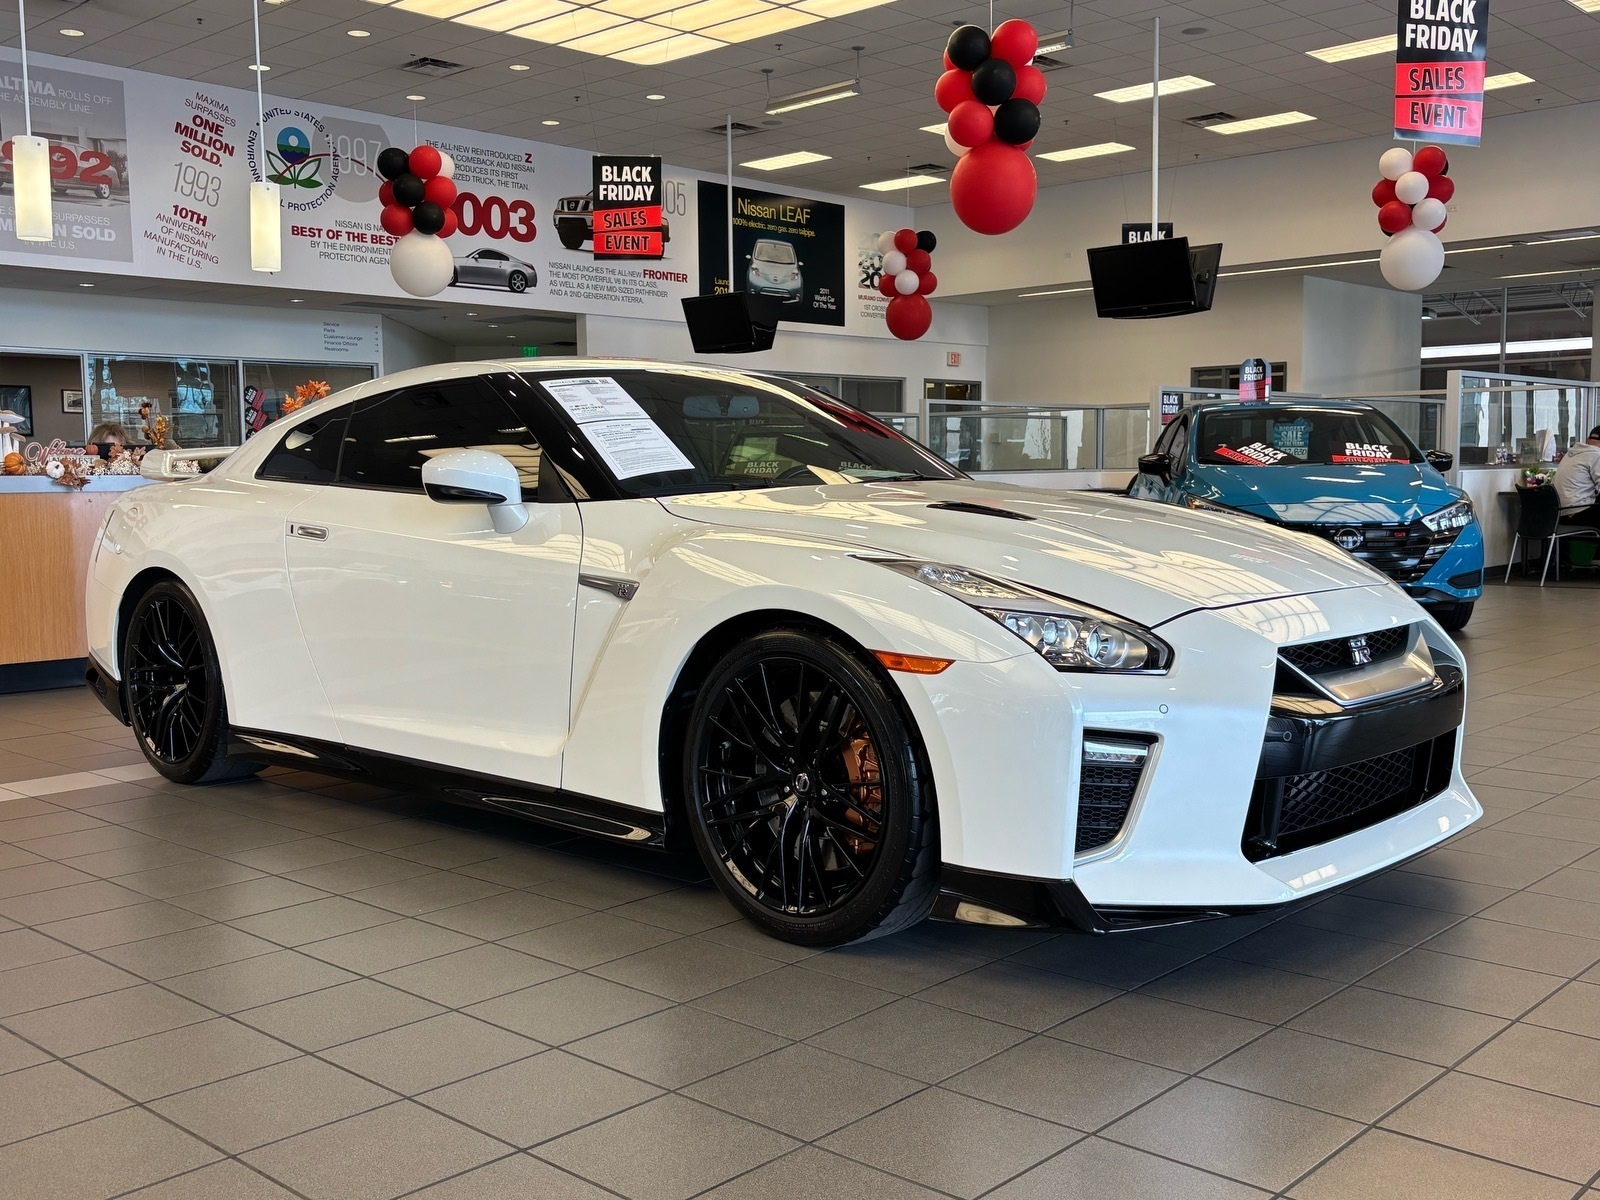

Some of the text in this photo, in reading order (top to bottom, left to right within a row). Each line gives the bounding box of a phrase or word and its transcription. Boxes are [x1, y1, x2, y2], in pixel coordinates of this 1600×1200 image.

[1410, 0, 1475, 24] BLACK
[1406, 23, 1478, 53] FRIDAY
[1410, 67, 1464, 91] SALES
[59, 89, 90, 102] ROLLS
[93, 95, 112, 104] OFF
[196, 92, 229, 113] MAXIMA
[185, 99, 236, 127] SURPASSES
[1410, 102, 1467, 128] EVENT
[192, 114, 224, 137] ONE
[175, 122, 234, 156] MILLION
[181, 140, 222, 167] SOLD.
[324, 134, 381, 178] 1997
[426, 140, 532, 163] THE ALL-NEW REINTRODUCED Z
[455, 164, 488, 175] RODUCES
[501, 171, 518, 180] FIRST
[456, 154, 495, 167] COMEBACK
[511, 163, 535, 173] NISSAN
[452, 173, 470, 182] SIZED
[472, 176, 496, 186] TRUCK,
[510, 182, 529, 190] TITAN.
[602, 166, 652, 182] BLACK
[175, 162, 221, 207] 1993
[600, 185, 654, 200] FRIDAY
[288, 183, 336, 211] PROTECTION
[53, 212, 110, 226] SURPASSES
[173, 204, 207, 226] 10TH
[450, 192, 537, 243] 003
[603, 211, 647, 228] SALES
[738, 198, 810, 224] Nissan LEAF
[72, 225, 116, 241] SOLD
[156, 213, 216, 241] ANNIVERSARY
[335, 220, 362, 230] NISSAN
[161, 226, 207, 249] OF NISSAN
[291, 226, 400, 246] BEST OF THE BEST
[606, 236, 649, 250] EVENT
[1129, 231, 1166, 243] BLAK
[144, 230, 219, 264] MANUFACTURING
[323, 242, 337, 250] THE
[340, 243, 391, 256] ENVIRONMENT
[157, 246, 202, 269] IN THE U.S.
[320, 251, 390, 265] PROTECTION AGEN
[549, 262, 571, 270] NISSAN
[572, 264, 604, 274] LAUNCHES
[643, 269, 688, 283] FRONTIER
[581, 274, 613, 283] POWERFUL
[636, 289, 668, 298] PATHFINDER
[1164, 395, 1178, 404] BLACK
[1163, 405, 1179, 414] FRIDAY
[1281, 431, 1302, 440] SALE
[25, 438, 86, 465] Welcome
[1237, 446, 1278, 465] FRIDAY
[1249, 442, 1287, 460] BLACK
[1345, 442, 1388, 452] BLACK
[1345, 449, 1392, 458] FRIDAY
